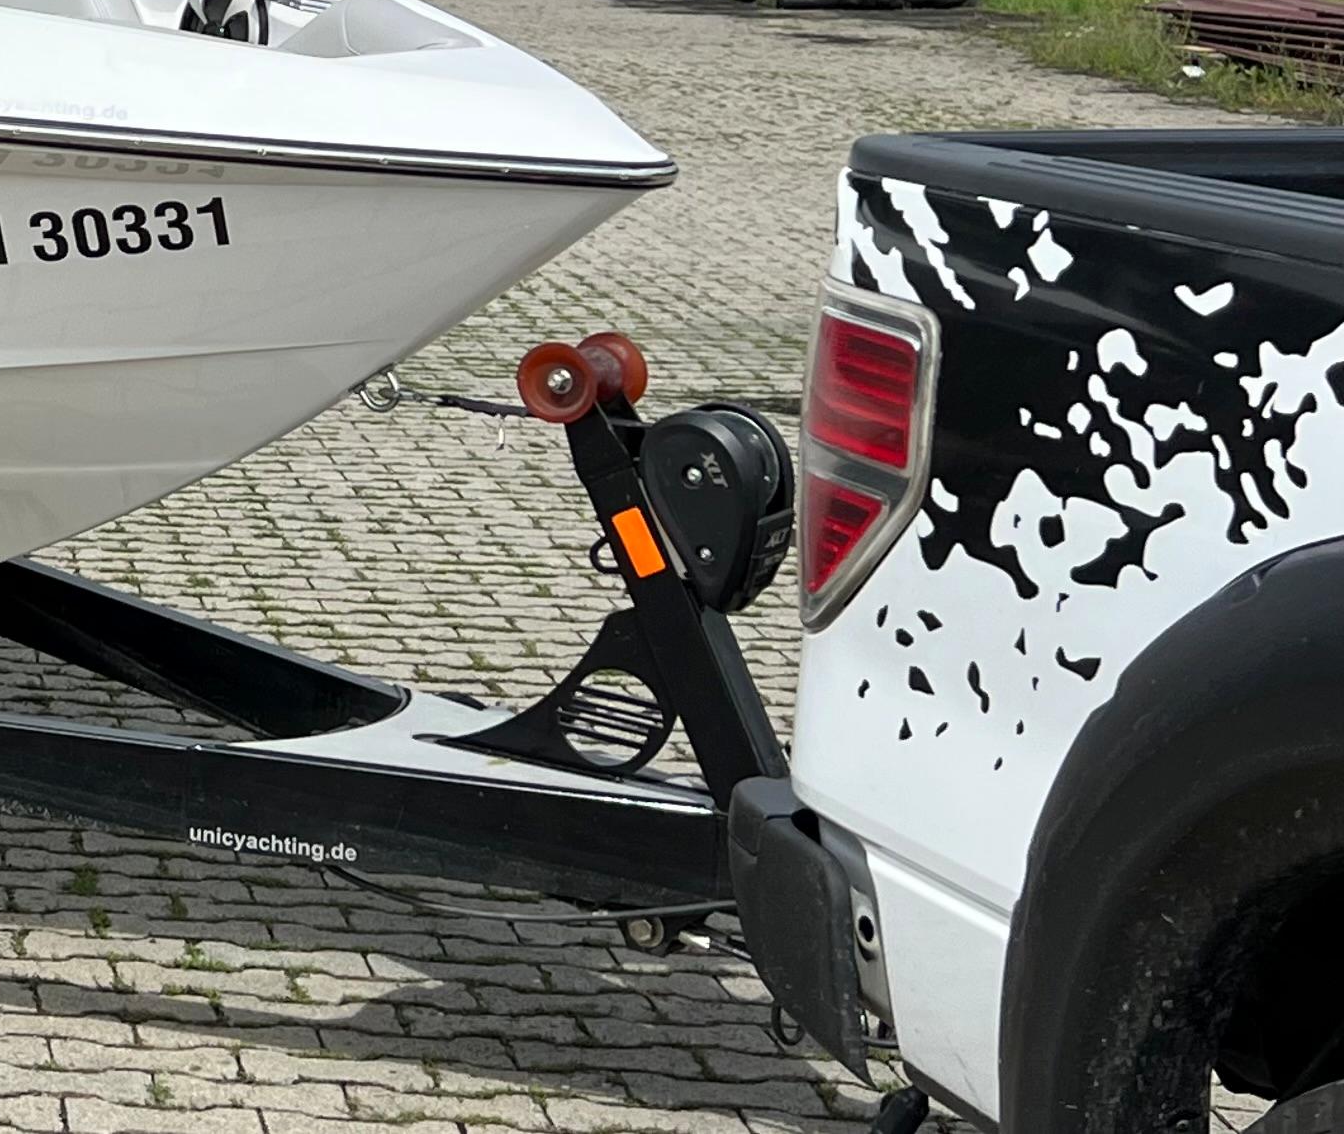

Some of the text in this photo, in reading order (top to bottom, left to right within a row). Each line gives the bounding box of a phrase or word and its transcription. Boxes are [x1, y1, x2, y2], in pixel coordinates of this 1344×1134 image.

[28, 196, 231, 263] 30331
[700, 453, 729, 488] XLT
[189, 827, 358, 862] unicyachting.de
